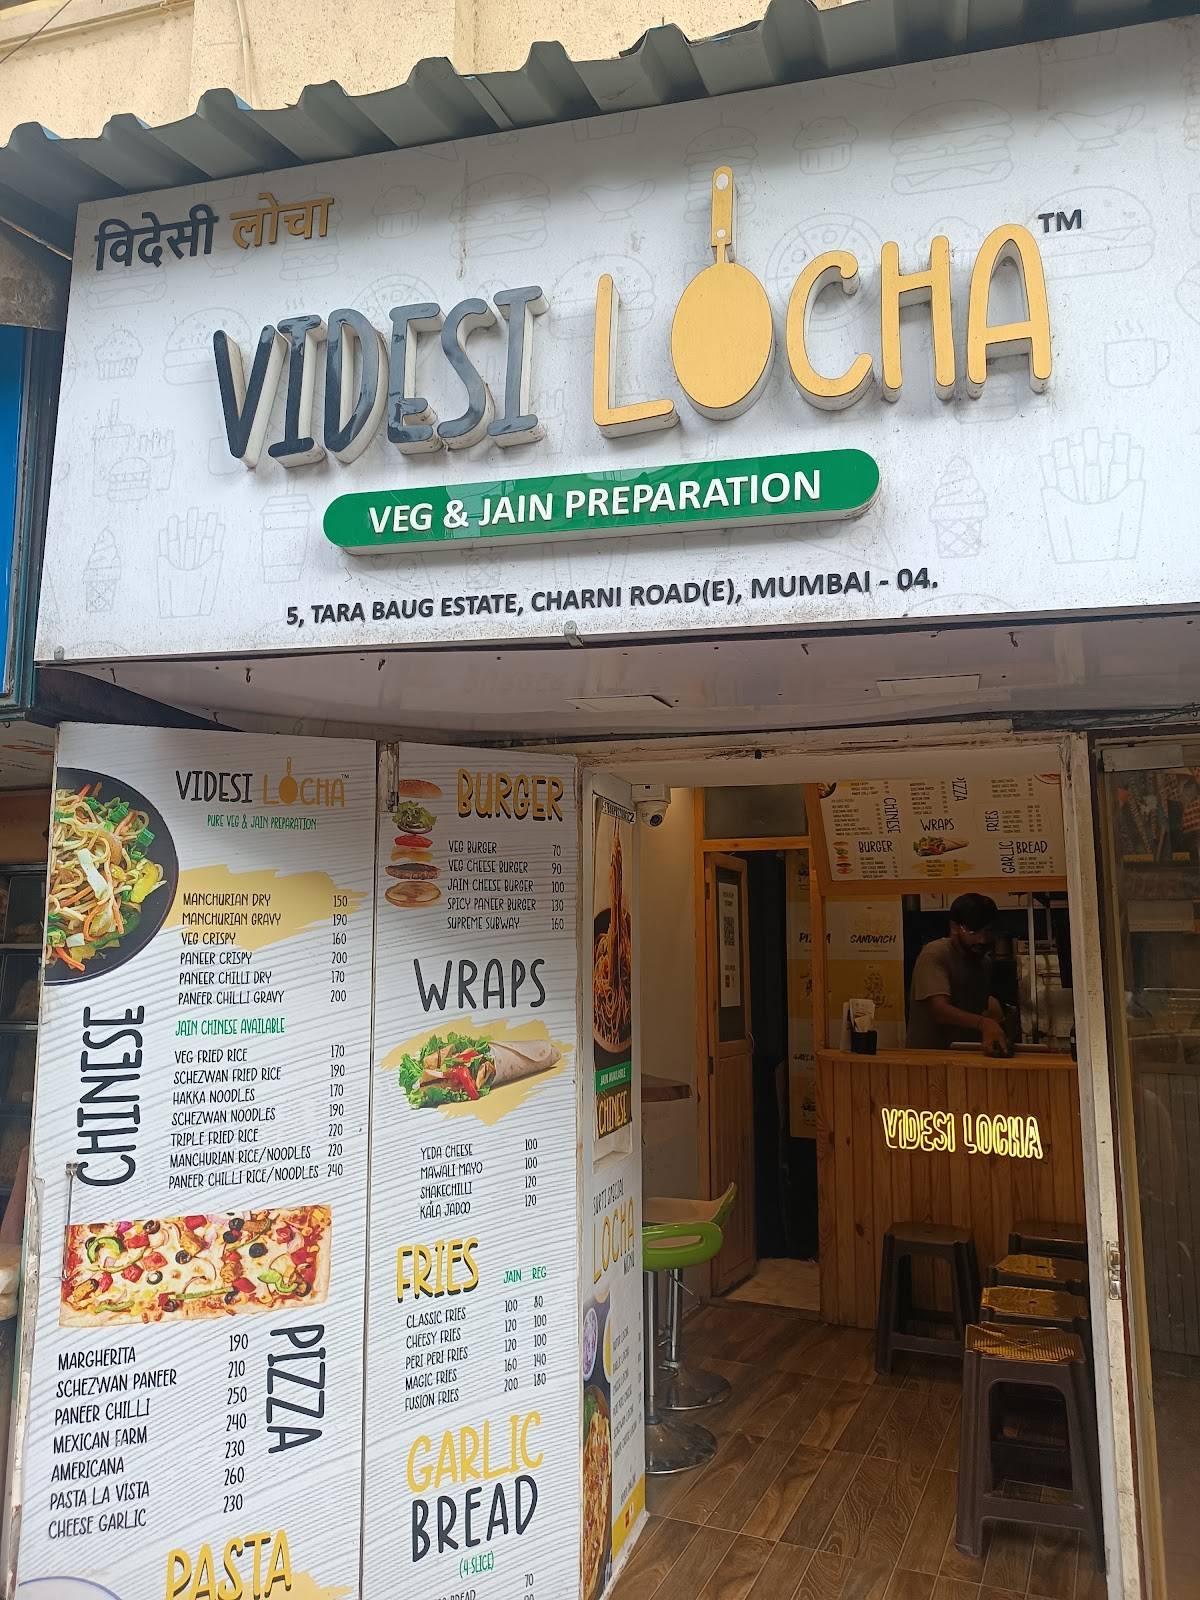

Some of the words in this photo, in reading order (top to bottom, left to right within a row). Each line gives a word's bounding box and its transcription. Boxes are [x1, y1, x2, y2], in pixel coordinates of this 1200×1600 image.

[95, 204, 218, 270] विदेसी
[231, 193, 334, 249] लोचा
[213, 286, 546, 464] VIDESI
[593, 166, 1052, 436] LOCHA
[1038, 209, 1083, 234] TM
[369, 502, 432, 534] VEG
[443, 499, 469, 528] &
[478, 493, 553, 526] JAIN
[565, 470, 820, 518] PREPARATION
[287, 606, 304, 628] 5,
[311, 603, 365, 623] TARA
[372, 598, 434, 620] BAUG
[441, 593, 524, 616] ESTATE,
[531, 586, 625, 611] CHARNI
[630, 578, 742, 607] ROAD(E),
[752, 570, 871, 599] MUMBAI
[897, 567, 938, 592] 04.
[176, 770, 253, 803] VIDESI
[262, 757, 345, 807] LOCHA
[457, 768, 564, 822] BURGER
[207, 814, 224, 827] PURE
[226, 816, 239, 828] VEG
[241, 814, 248, 829] &
[251, 817, 269, 829] JAIN
[271, 818, 317, 831] PREPARATION
[884, 797, 900, 834] CHINESE
[920, 817, 954, 831] WRAPS
[986, 810, 999, 832] FRIES
[448, 840, 464, 854] VEG
[467, 841, 497, 854] BURGER
[858, 840, 893, 853] BURGER
[998, 840, 1016, 873] GARLIC
[1016, 840, 1048, 854] BREAD
[448, 859, 464, 872] VEG
[467, 860, 496, 873] CHEESE
[499, 861, 528, 874] BURGER
[447, 879, 469, 891] JAIN
[472, 879, 501, 892] CHEESE
[504, 880, 533, 892] BURGER
[551, 881, 565, 893] 100
[183, 893, 249, 906] MANCHURIAN
[252, 893, 271, 908] DRY
[333, 895, 348, 908] 150
[447, 898, 470, 911] SPICY
[474, 898, 504, 911] PANEER
[507, 899, 536, 911] BURGER
[551, 900, 564, 912] 130
[182, 912, 248, 926] MANCHURIAN
[251, 913, 281, 927] GRAVY
[332, 914, 348, 927] 190
[447, 917, 482, 930] SUPREME
[486, 917, 520, 930] SUBWAY
[551, 918, 564, 930] 160
[181, 932, 199, 945] VEG
[202, 932, 236, 945] CRISPY
[332, 933, 347, 946] 160
[850, 934, 897, 944] SANDWICH
[180, 952, 216, 965] PANEER
[218, 951, 253, 965] CRISPY
[331, 952, 348, 964] 200
[179, 971, 215, 985] PANEER
[217, 971, 250, 985] CHILLI
[252, 970, 272, 984] DRY
[331, 971, 345, 984] 170
[414, 958, 545, 1012] WRAPS
[178, 991, 213, 1006] PANEER
[216, 990, 250, 1005] CHILLI
[253, 990, 285, 1004] GRAVY
[330, 990, 346, 1003] 200
[175, 1020, 198, 1036] JAIN
[200, 1019, 238, 1035] CHINESE
[240, 1018, 285, 1035] AVAILABLE
[175, 1050, 193, 1064] VEG
[197, 1049, 224, 1063] FRIED
[227, 1048, 248, 1062] RICE
[330, 1045, 345, 1058] 170
[173, 1070, 228, 1085] SCHEZWAN
[232, 1069, 259, 1082] FRIED
[262, 1066, 282, 1080] RICE
[330, 1064, 345, 1078] 190
[76, 1006, 145, 1187] CHINESE
[173, 1091, 206, 1105] HAKKA
[209, 1088, 255, 1103] NOODLES
[329, 1084, 344, 1097] 170
[172, 1111, 227, 1126] SCHEZWAN
[230, 1108, 276, 1123] NOODLES
[329, 1104, 344, 1117] 190
[171, 1132, 204, 1147] TRIPLE
[208, 1130, 234, 1145] FRIED
[238, 1129, 259, 1143] RICE
[328, 1123, 343, 1137] 220
[882, 1108, 956, 1153] VIDESI
[963, 1113, 1043, 1159] LOCHA
[170, 1151, 234, 1168] MANCHURIAN
[238, 1146, 311, 1163] RICE/NOODLES
[328, 1144, 343, 1157] 220
[421, 1146, 442, 1160] YEDA
[445, 1143, 473, 1158] CHEESE
[169, 1173, 204, 1189] PANEER
[208, 1170, 242, 1186] CHILLI
[246, 1166, 319, 1183] RICE/NOODLES
[327, 1164, 343, 1177] 240
[421, 1164, 455, 1180] MAWALI
[459, 1162, 483, 1176] MAYO
[420, 1182, 472, 1199] SHAKECHILLI
[445, 1201, 470, 1216] JADOO
[592, 1196, 635, 1284] LOCHA
[396, 1237, 479, 1303] FRIES
[504, 1268, 522, 1284] JAIN
[532, 1266, 547, 1279] REG
[406, 1311, 442, 1329] CLASSIC
[445, 1307, 467, 1323] FRIES
[229, 1334, 249, 1352] 190
[406, 1332, 439, 1349] CHEESY
[440, 1328, 462, 1344] FRIES
[58, 1347, 136, 1371] MARGHERITA
[405, 1353, 424, 1370] PERI
[426, 1350, 444, 1367] PERI
[447, 1347, 468, 1363] FRIES
[228, 1360, 246, 1378] 210
[56, 1374, 128, 1398] SCHEZWAN
[134, 1369, 177, 1389] PANEER
[266, 1324, 326, 1454] PIZZA
[405, 1373, 433, 1391] MAGIC
[436, 1369, 457, 1385] FRIES
[227, 1387, 247, 1405] 250
[405, 1393, 435, 1411] FUSION
[438, 1388, 460, 1405] FRIES
[55, 1405, 100, 1426] PANEER
[106, 1398, 151, 1420] CHILLI
[226, 1414, 246, 1432] 240
[53, 1432, 109, 1454] MEXICAN
[115, 1426, 148, 1447] FARM
[225, 1440, 245, 1458] 230
[406, 1411, 544, 1493] GARLIC
[51, 1457, 125, 1482] AMERICANA
[224, 1467, 245, 1486] 260
[50, 1488, 88, 1510] PASTA
[93, 1486, 109, 1506] LA
[115, 1481, 150, 1501] VISTA
[223, 1494, 243, 1513] 230
[48, 1516, 93, 1539] CHEESE
[98, 1509, 147, 1532] GARLIC
[412, 1474, 538, 1562] BREAD
[166, 1529, 292, 1600] PASTA
[471, 1551, 494, 1574] SLICE)
[525, 1573, 534, 1588] 70
